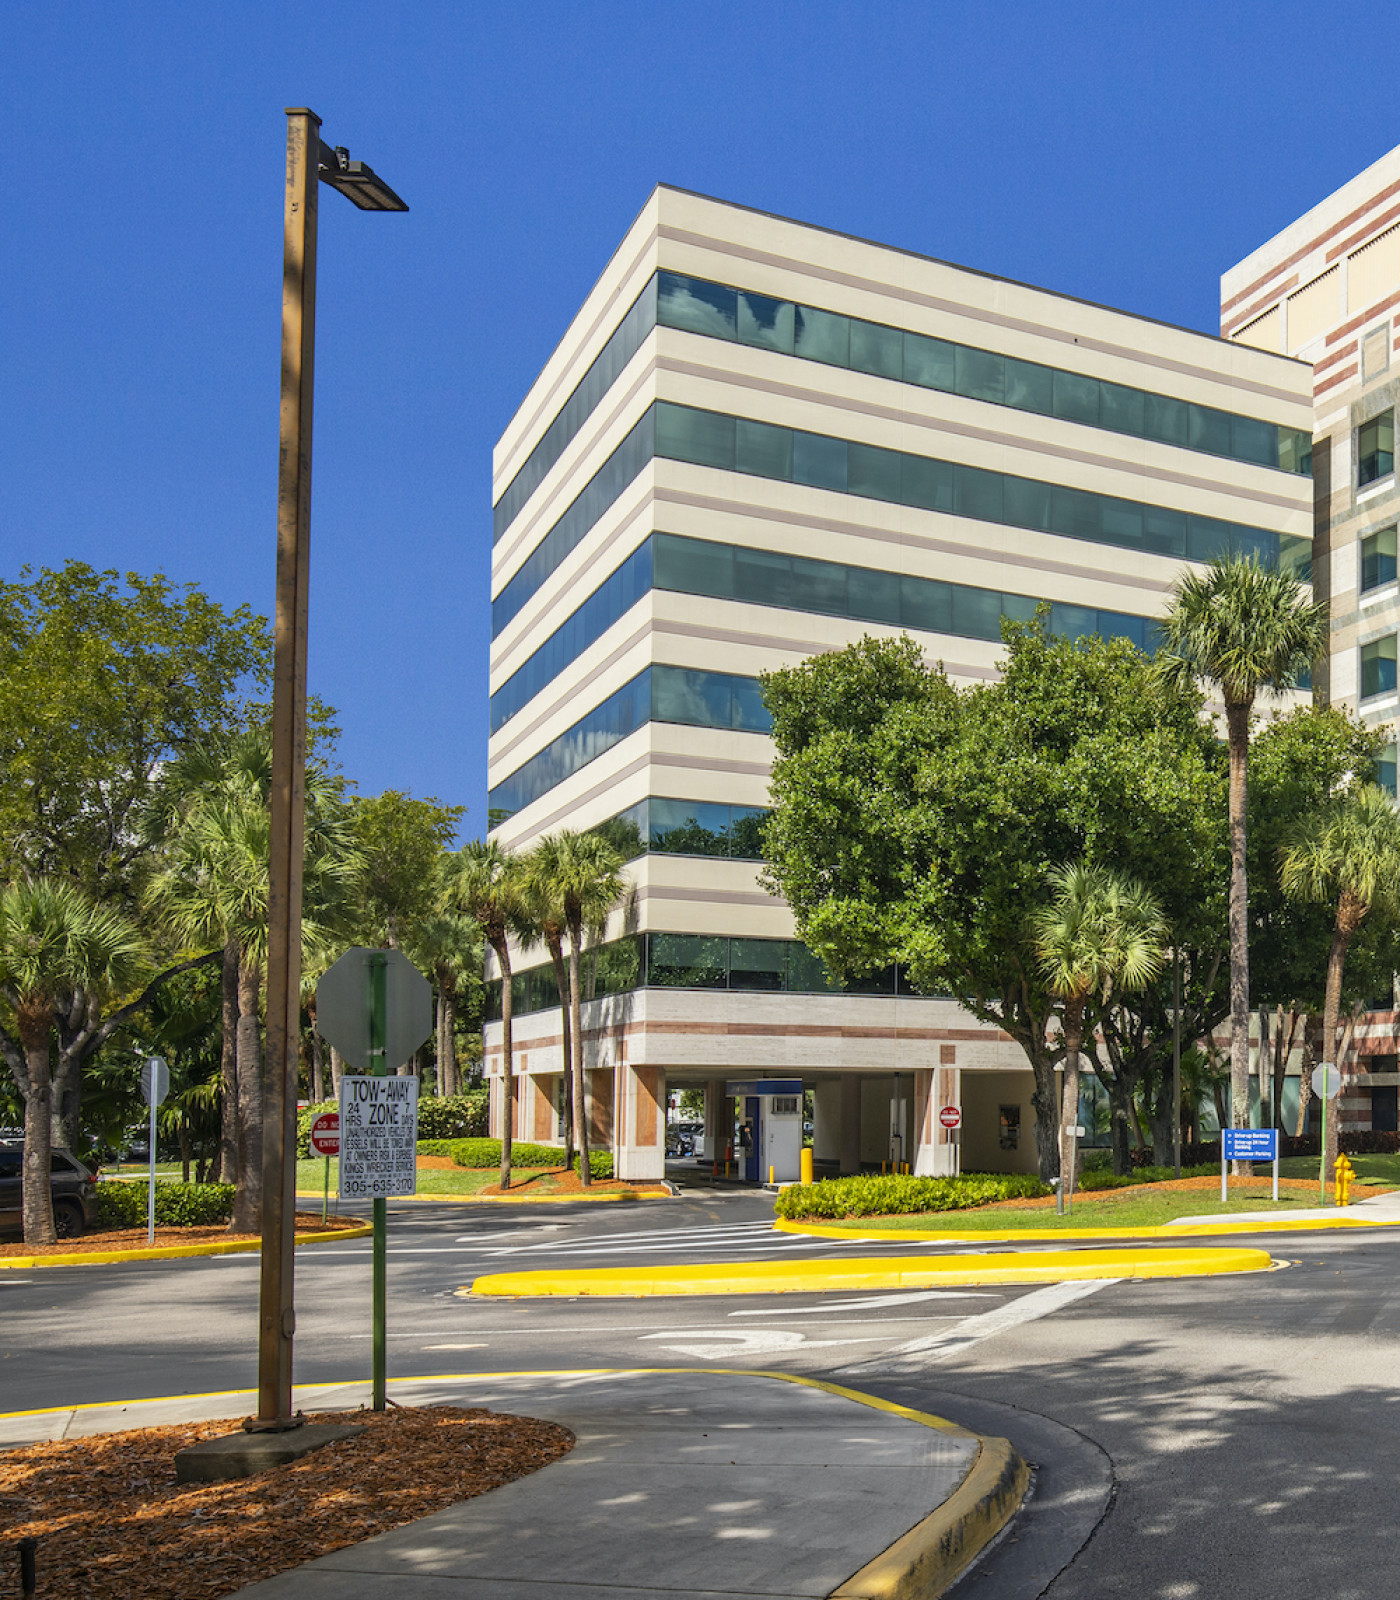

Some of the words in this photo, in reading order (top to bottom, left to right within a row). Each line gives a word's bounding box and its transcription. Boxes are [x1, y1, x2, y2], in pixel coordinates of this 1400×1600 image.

[351, 1080, 409, 1102] TOW-AWAY
[348, 1102, 359, 1114] 24
[369, 1103, 399, 1125] ZONE
[405, 1102, 410, 1114] 7
[317, 1121, 328, 1129] DO
[345, 1114, 361, 1126] HRS
[345, 1126, 386, 1138] UNAUTHORIZED
[344, 1162, 365, 1174] KINGS
[366, 1161, 394, 1173] WRECKER
[344, 1178, 413, 1194] 305-635-3170
